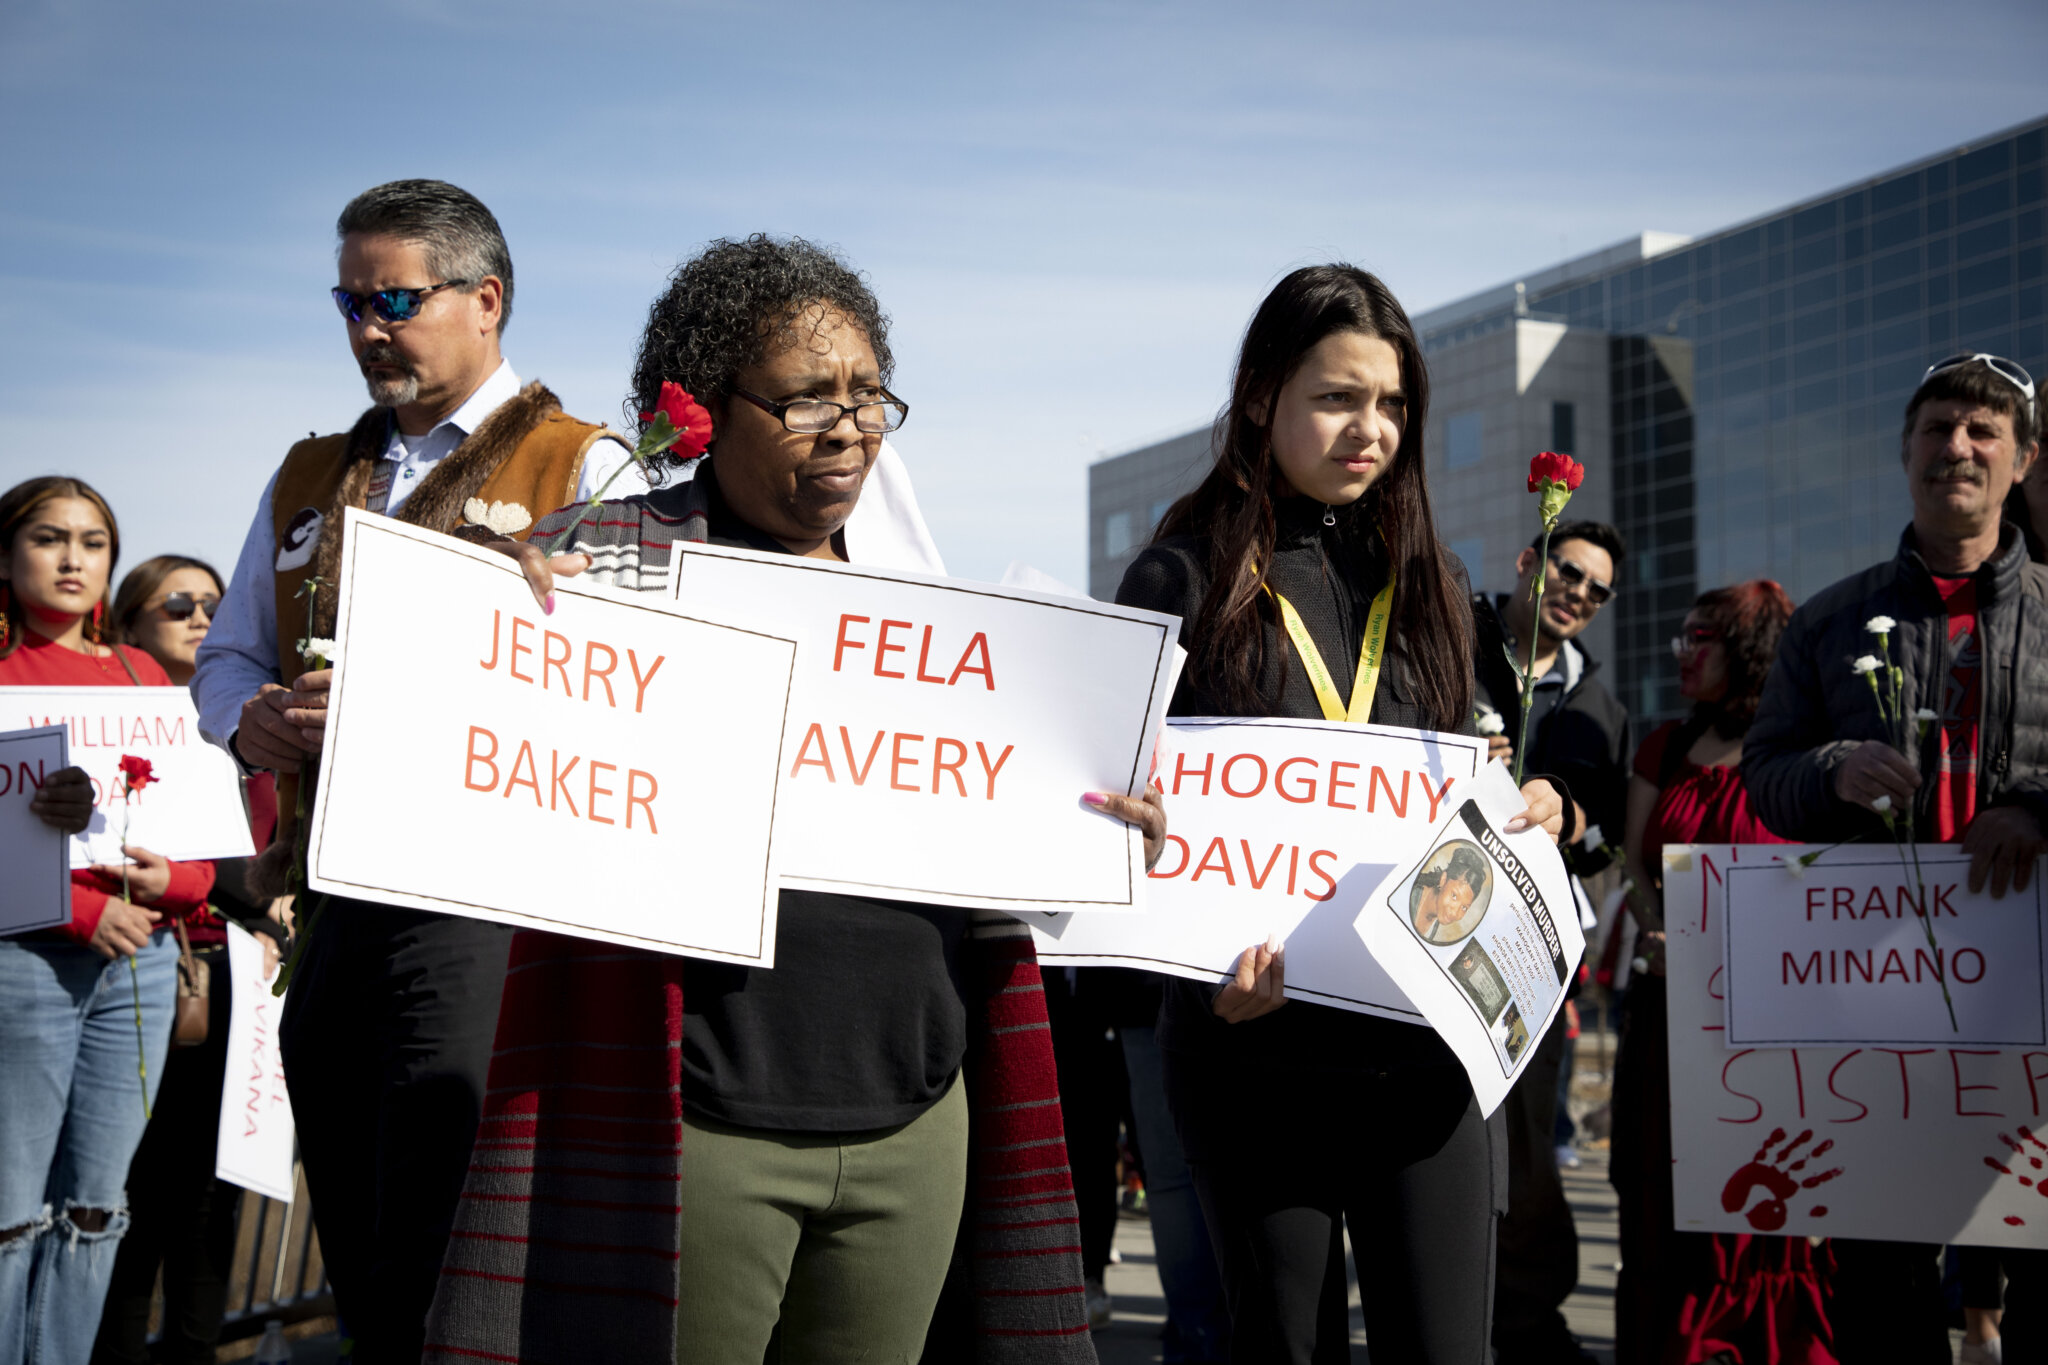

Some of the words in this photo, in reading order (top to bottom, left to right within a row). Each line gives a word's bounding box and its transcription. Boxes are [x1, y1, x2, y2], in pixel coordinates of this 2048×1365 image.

[833, 614, 995, 691] FELA
[1290, 619, 1304, 641] Ryan
[1302, 642, 1328, 692] Wolverines
[1372, 613, 1384, 635] Ryan
[480, 609, 666, 713] JERRY
[1363, 637, 1380, 685] Wolverines
[465, 725, 658, 834] BAKER
[790, 723, 1015, 800] AVERY
[1154, 753, 1455, 823] HOGENY
[1147, 835, 1337, 901] DAVIS
[1481, 828, 1537, 903] UNSOLVED
[1532, 899, 1561, 961] MURDER!
[1806, 884, 1959, 921] FRANK
[1533, 961, 1543, 982] DAVIS
[1782, 948, 1986, 985] MINANO
